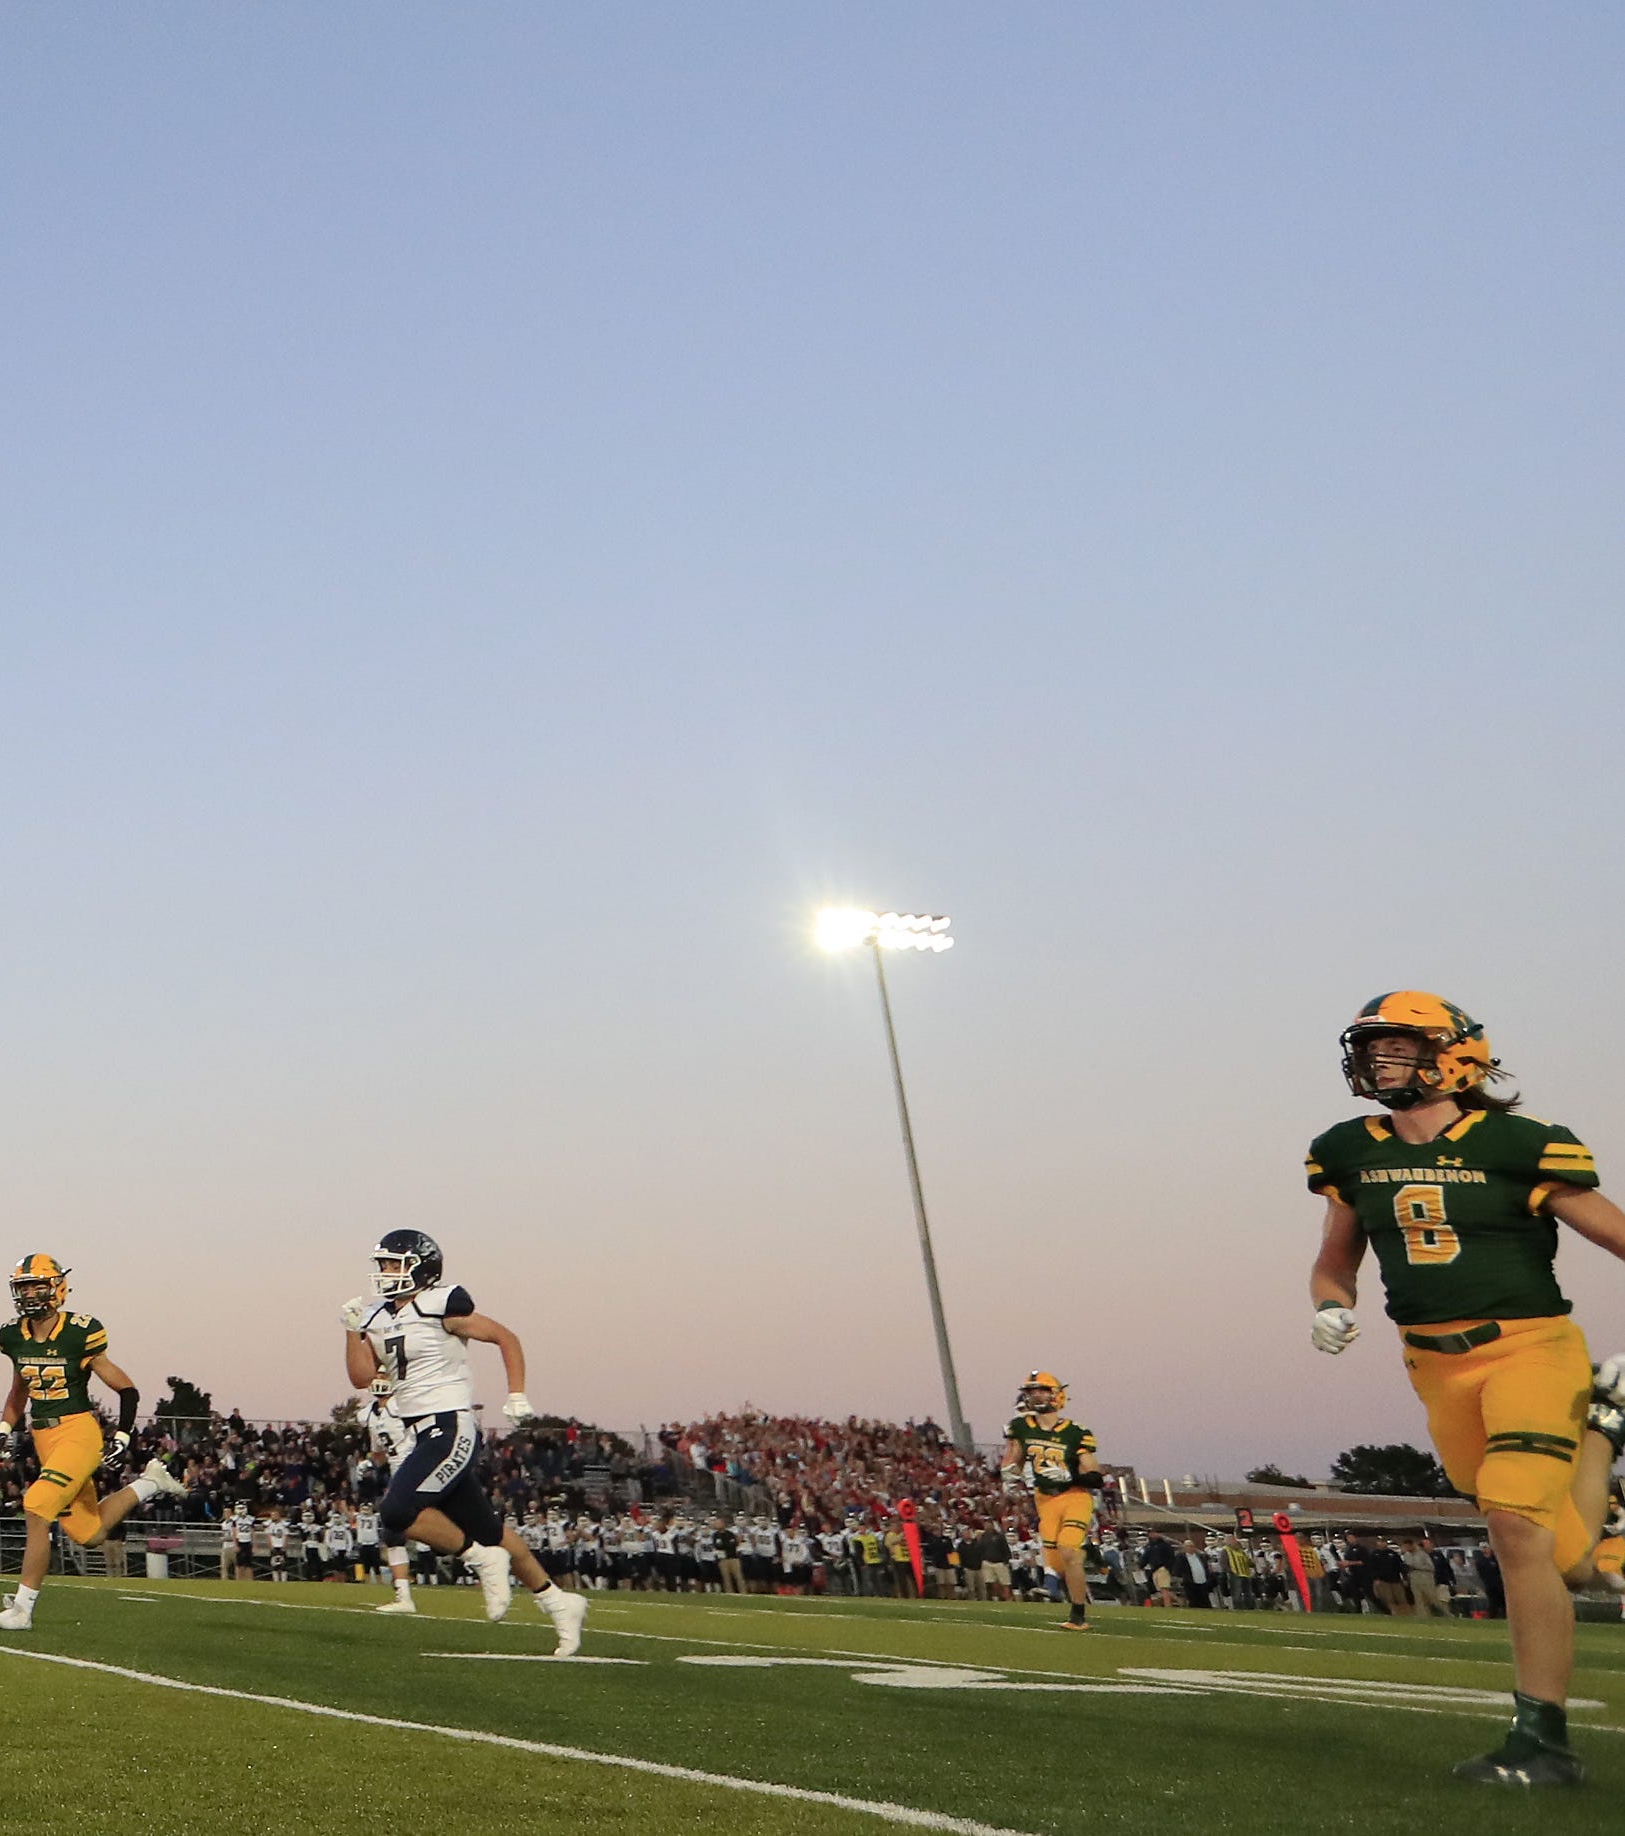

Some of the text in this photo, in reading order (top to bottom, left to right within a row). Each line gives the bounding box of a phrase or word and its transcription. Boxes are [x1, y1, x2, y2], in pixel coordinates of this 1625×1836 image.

[1393, 1184, 1462, 1266] 8
[384, 1335, 408, 1381] 7
[20, 1365, 70, 1401] 22
[435, 1436, 471, 1484] PIRATES
